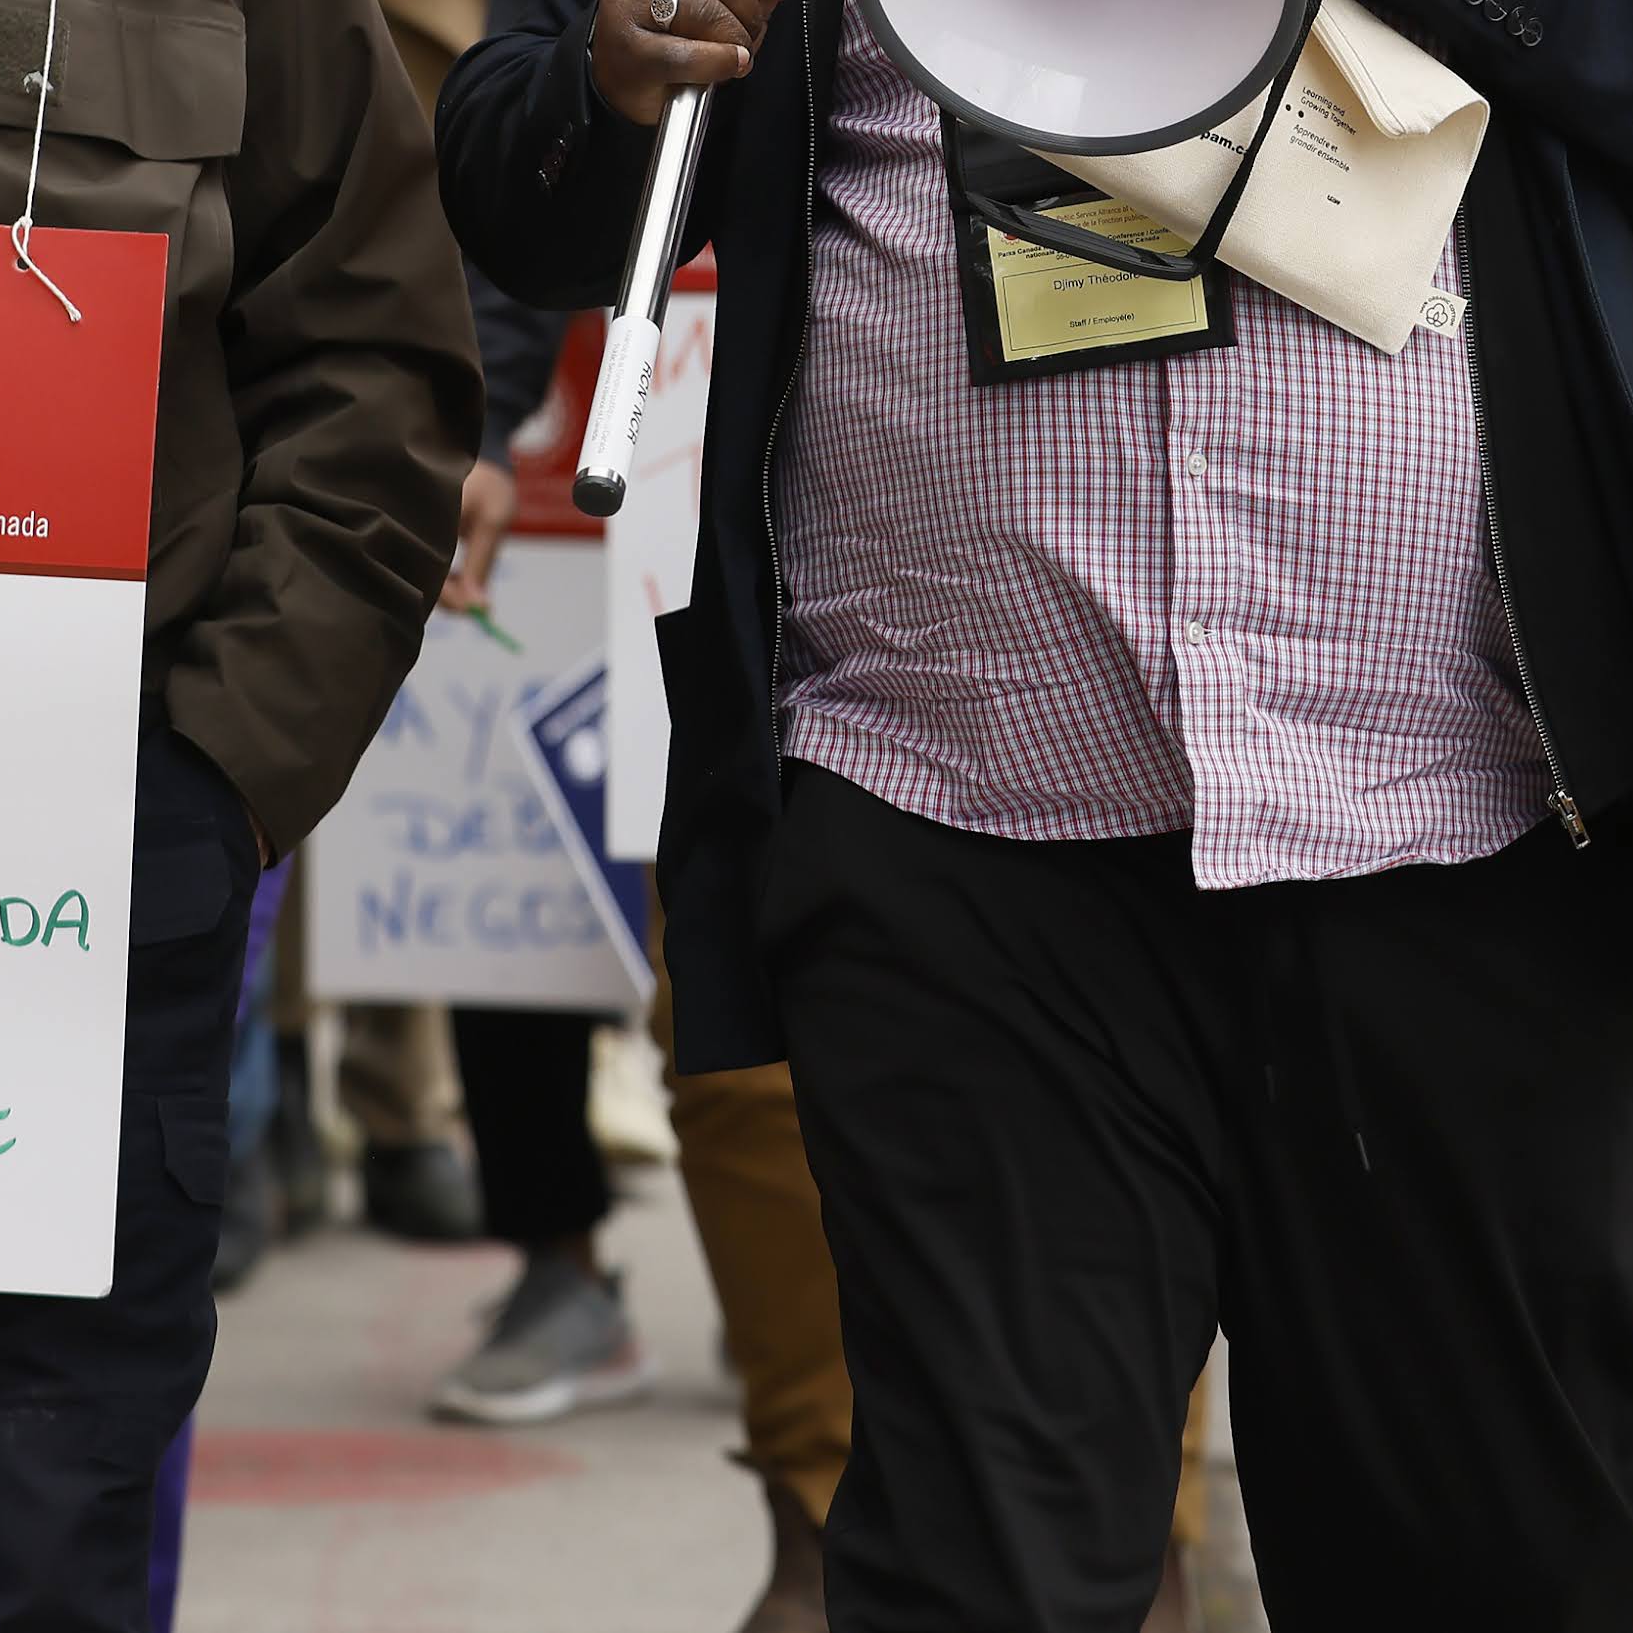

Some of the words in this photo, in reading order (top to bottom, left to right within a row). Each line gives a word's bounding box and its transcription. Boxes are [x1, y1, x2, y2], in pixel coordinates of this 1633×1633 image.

[1300, 96, 1331, 120] Growing
[1331, 111, 1357, 136] Together
[1302, 86, 1333, 110] Learning
[1333, 104, 1346, 117] and
[1200, 131, 1250, 156] pam.c
[1293, 123, 1330, 149] Apprendre
[1330, 142, 1338, 153] et
[1289, 135, 1317, 154] grandir
[1317, 149, 1350, 173] ensemble
[1053, 278, 1084, 291] Djimy
[1069, 319, 1086, 328] Staff
